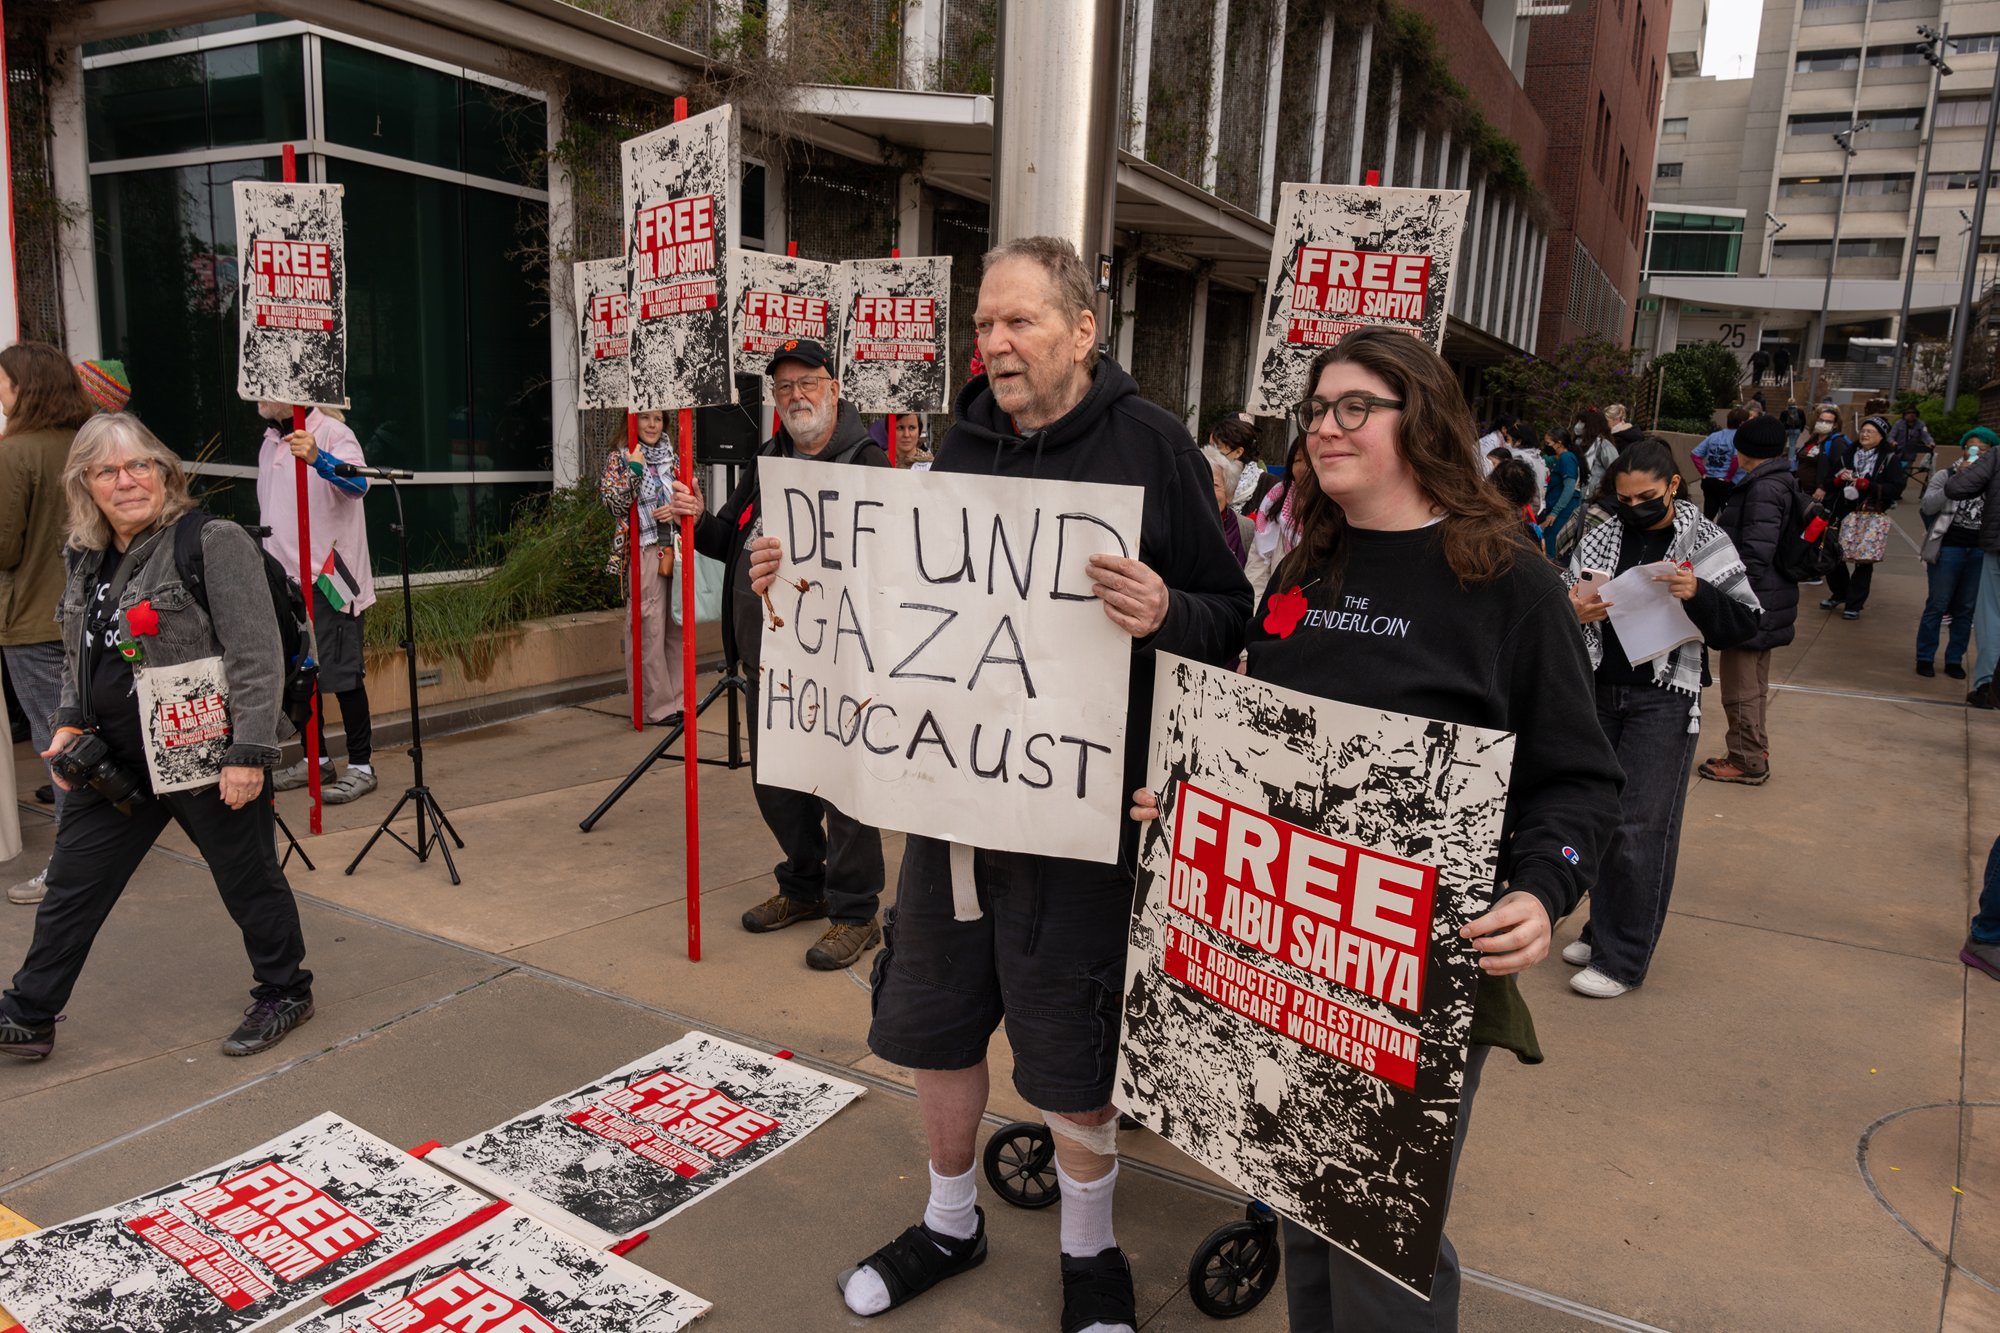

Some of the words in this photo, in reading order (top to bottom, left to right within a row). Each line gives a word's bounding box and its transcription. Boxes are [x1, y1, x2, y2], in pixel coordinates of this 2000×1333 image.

[640, 198, 711, 251] FREE
[256, 242, 328, 277] FREE
[640, 252, 655, 282] DR.
[658, 246, 677, 278] ABU
[678, 240, 715, 274] SAFIYA
[1299, 249, 1425, 292] FREE
[256, 274, 273, 297] DR.
[274, 275, 294, 298] ABU
[294, 276, 331, 300] SAFIYA
[645, 291, 654, 304] ALL
[655, 286, 680, 303] ABDUCTED
[682, 281, 716, 298] PALESTINIAN
[261, 305, 270, 315] ALL
[270, 306, 298, 318] ABDUCTED
[298, 308, 332, 320] PALESTINIAN
[594, 295, 628, 320] FR
[649, 300, 680, 317] HEALTHCARE
[681, 297, 707, 312] WORKERS
[748, 293, 825, 321] FREE
[858, 299, 931, 322] FREE
[1293, 284, 1321, 311] DR.
[1324, 287, 1361, 314] ABU
[1362, 291, 1423, 320] SAFIYA
[265, 316, 297, 328] HEALTHCARE
[298, 319, 324, 330] WORKERS
[594, 321, 610, 337] DR.
[745, 315, 763, 331] DR.
[765, 316, 787, 333] ABU
[788, 319, 824, 337] SAFIYA
[857, 321, 873, 338] DR.
[874, 321, 895, 338] ABU
[897, 322, 933, 339] SAFIYA
[1289, 319, 1295, 329] &
[1298, 320, 1313, 331] ALL
[1719, 323, 1746, 348] 25
[610, 339, 628, 349] ABDUCT
[749, 336, 759, 344] ALL
[871, 344, 897, 352] ABDUCTED
[899, 345, 934, 353] PALESTINIAN
[1302, 331, 1340, 345] HEALTHC
[864, 352, 896, 360] HEALTHCARE
[1345, 595, 1370, 610] THE
[1303, 609, 1410, 638] TENDERLOIN
[794, 581, 1037, 699] GAZA
[161, 693, 221, 720] FREE
[162, 720, 178, 732] DR.
[180, 715, 198, 730] ABU
[198, 708, 226, 726] SAFIYA
[766, 668, 1111, 799] HOLOCAUST
[1179, 788, 1424, 948] FREE
[1171, 859, 1213, 925] DR.
[1219, 883, 1284, 954] ABU
[1290, 914, 1420, 1013] SAFIYA
[1166, 928, 1175, 948] &
[1179, 933, 1202, 965] ALL
[1206, 948, 1287, 1006] ABDUCTED
[1293, 989, 1418, 1063] PALESTINIAN
[1187, 960, 1281, 1029] HEALTHCARE
[1287, 1012, 1377, 1072] WORKERS
[633, 1073, 775, 1141] FREE
[605, 1089, 645, 1113] DR.
[634, 1102, 686, 1124] ABU
[668, 1118, 743, 1157] SAFIYA
[581, 1118, 640, 1146] HEALTHCARE
[633, 1143, 682, 1169] WORKERS
[588, 1109, 610, 1121] ALL
[604, 1117, 654, 1140] ABDUCTED
[647, 1138, 713, 1171] PALESTINIAN
[184, 1187, 234, 1218] DR.
[224, 1164, 375, 1257] FREE
[207, 1204, 271, 1235] ABU
[140, 1224, 201, 1263] HEALTHCARE
[187, 1258, 239, 1298] WORKERS
[154, 1214, 181, 1229] ALL
[168, 1224, 221, 1256] ABDUCTED
[207, 1251, 275, 1301] PALESTINIAN
[241, 1224, 325, 1283] SAFIYA
